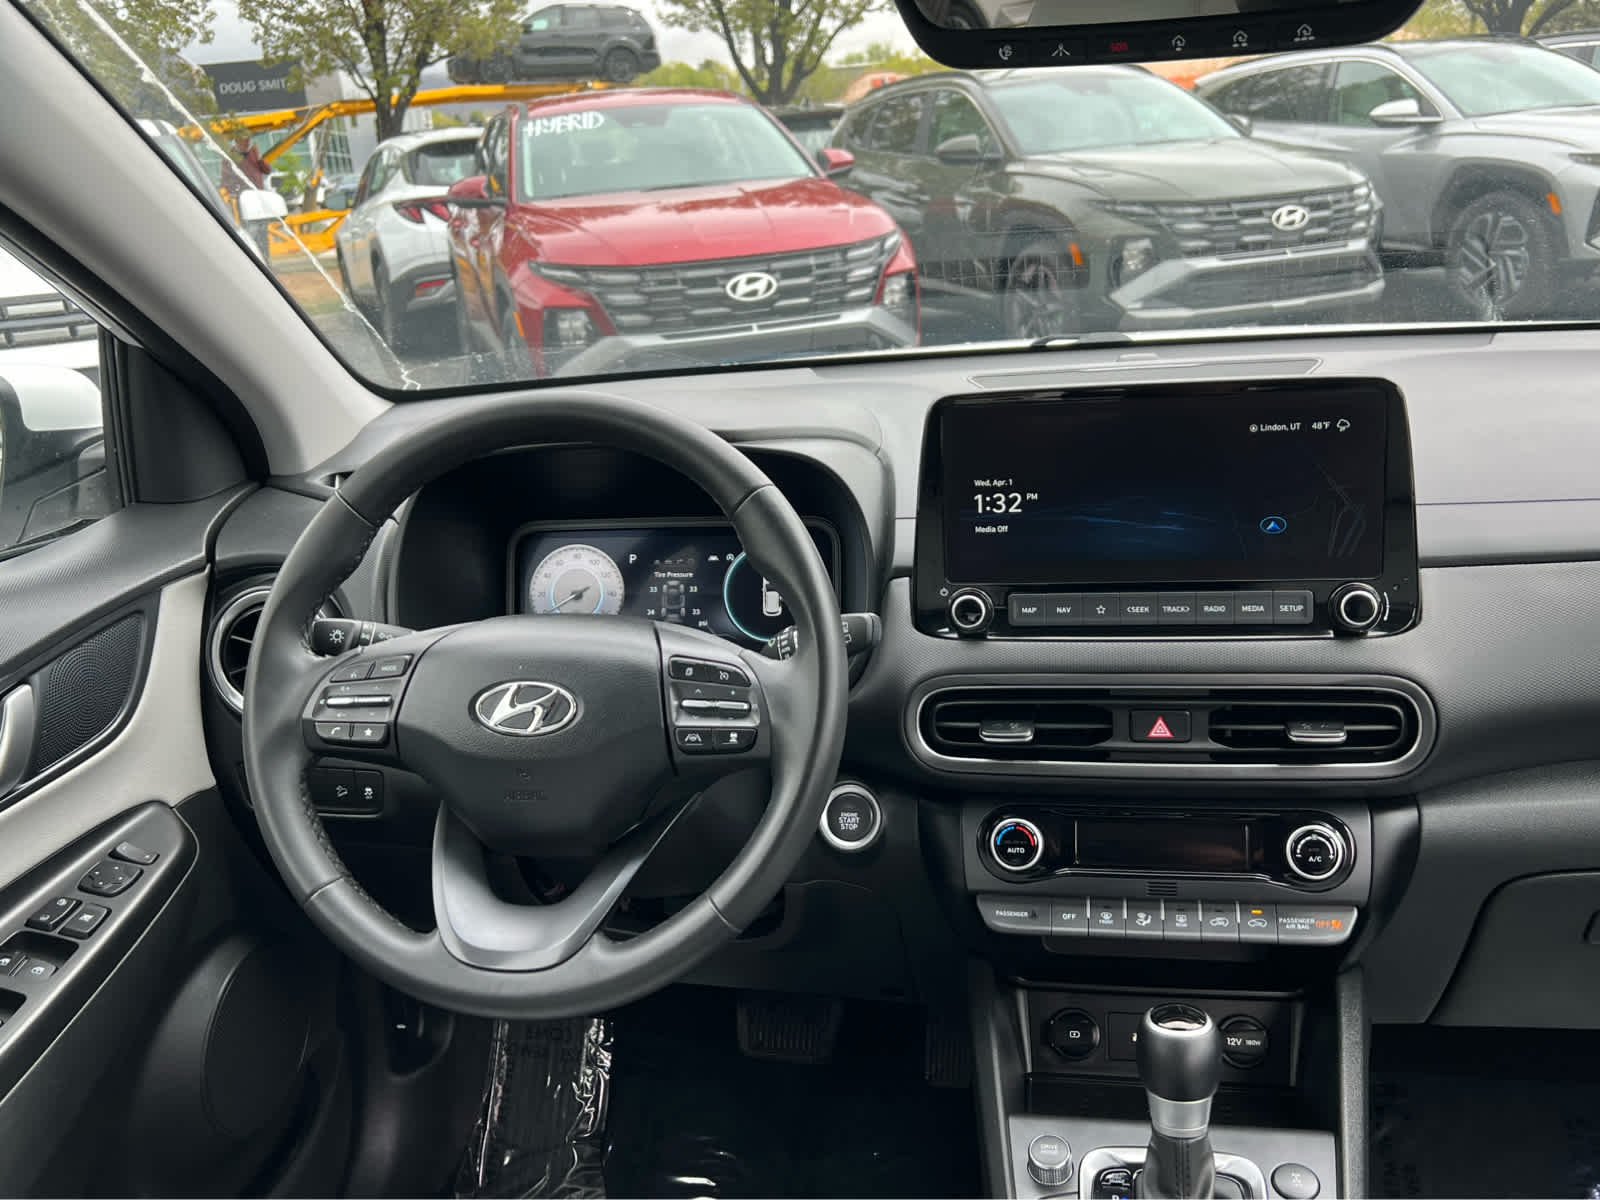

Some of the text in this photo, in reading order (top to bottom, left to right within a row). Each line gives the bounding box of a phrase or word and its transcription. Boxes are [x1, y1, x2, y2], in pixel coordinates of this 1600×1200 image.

[219, 79, 288, 95] DOUG SMIT
[522, 111, 606, 136] HYBRID
[1260, 423, 1289, 432] Lindon,
[1290, 422, 1301, 430] UT
[974, 492, 1022, 513] 1:32
[997, 525, 1008, 533] Off
[629, 554, 637, 564] P
[1279, 604, 1304, 612] SETUP
[840, 823, 858, 831] STOP
[1308, 855, 1322, 863] A/C
[995, 909, 1029, 918] PASSENGER
[1278, 917, 1316, 926] PASSENGER
[1315, 920, 1331, 929] OFF
[1226, 1037, 1243, 1046] 12V
